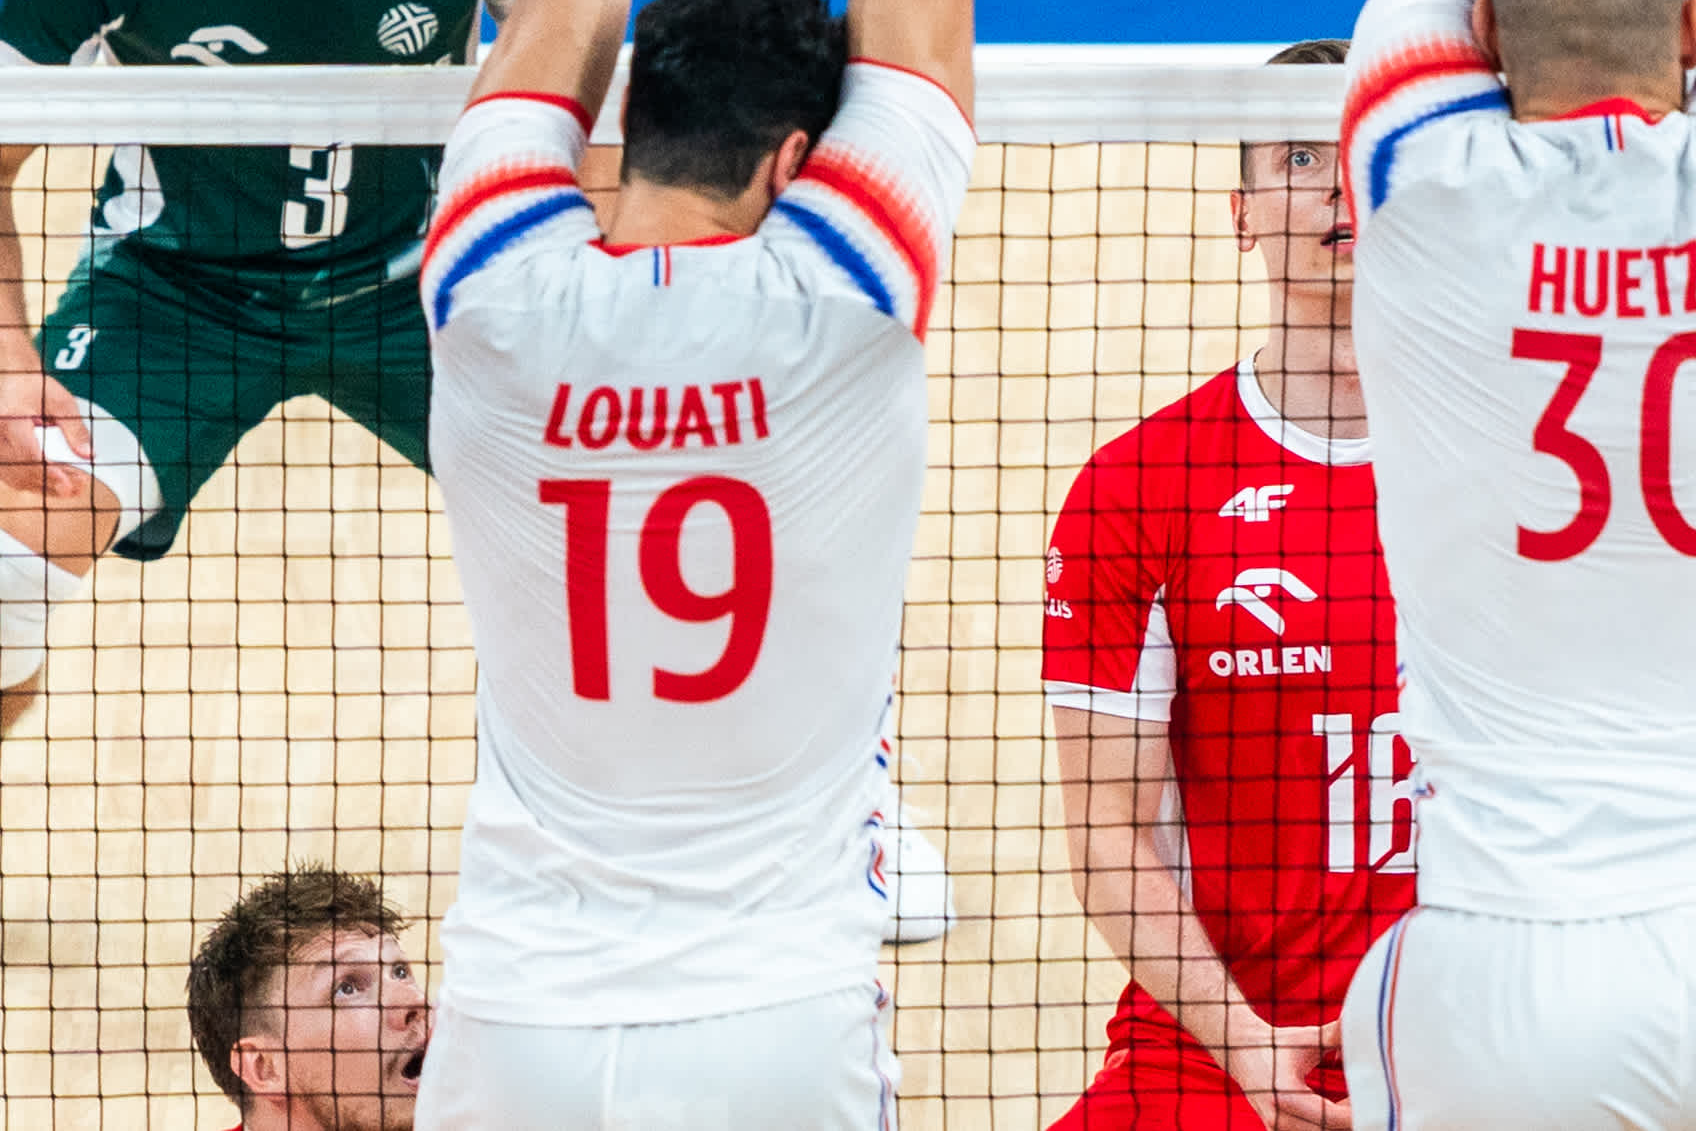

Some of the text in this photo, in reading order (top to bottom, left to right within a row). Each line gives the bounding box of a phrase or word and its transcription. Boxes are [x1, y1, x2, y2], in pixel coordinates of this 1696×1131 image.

[281, 144, 352, 249] 3
[54, 323, 98, 370] 3
[543, 377, 770, 450] LOUATI
[1218, 484, 1295, 522] 4F
[538, 475, 774, 704] 19
[1208, 646, 1332, 677] ORLEN
